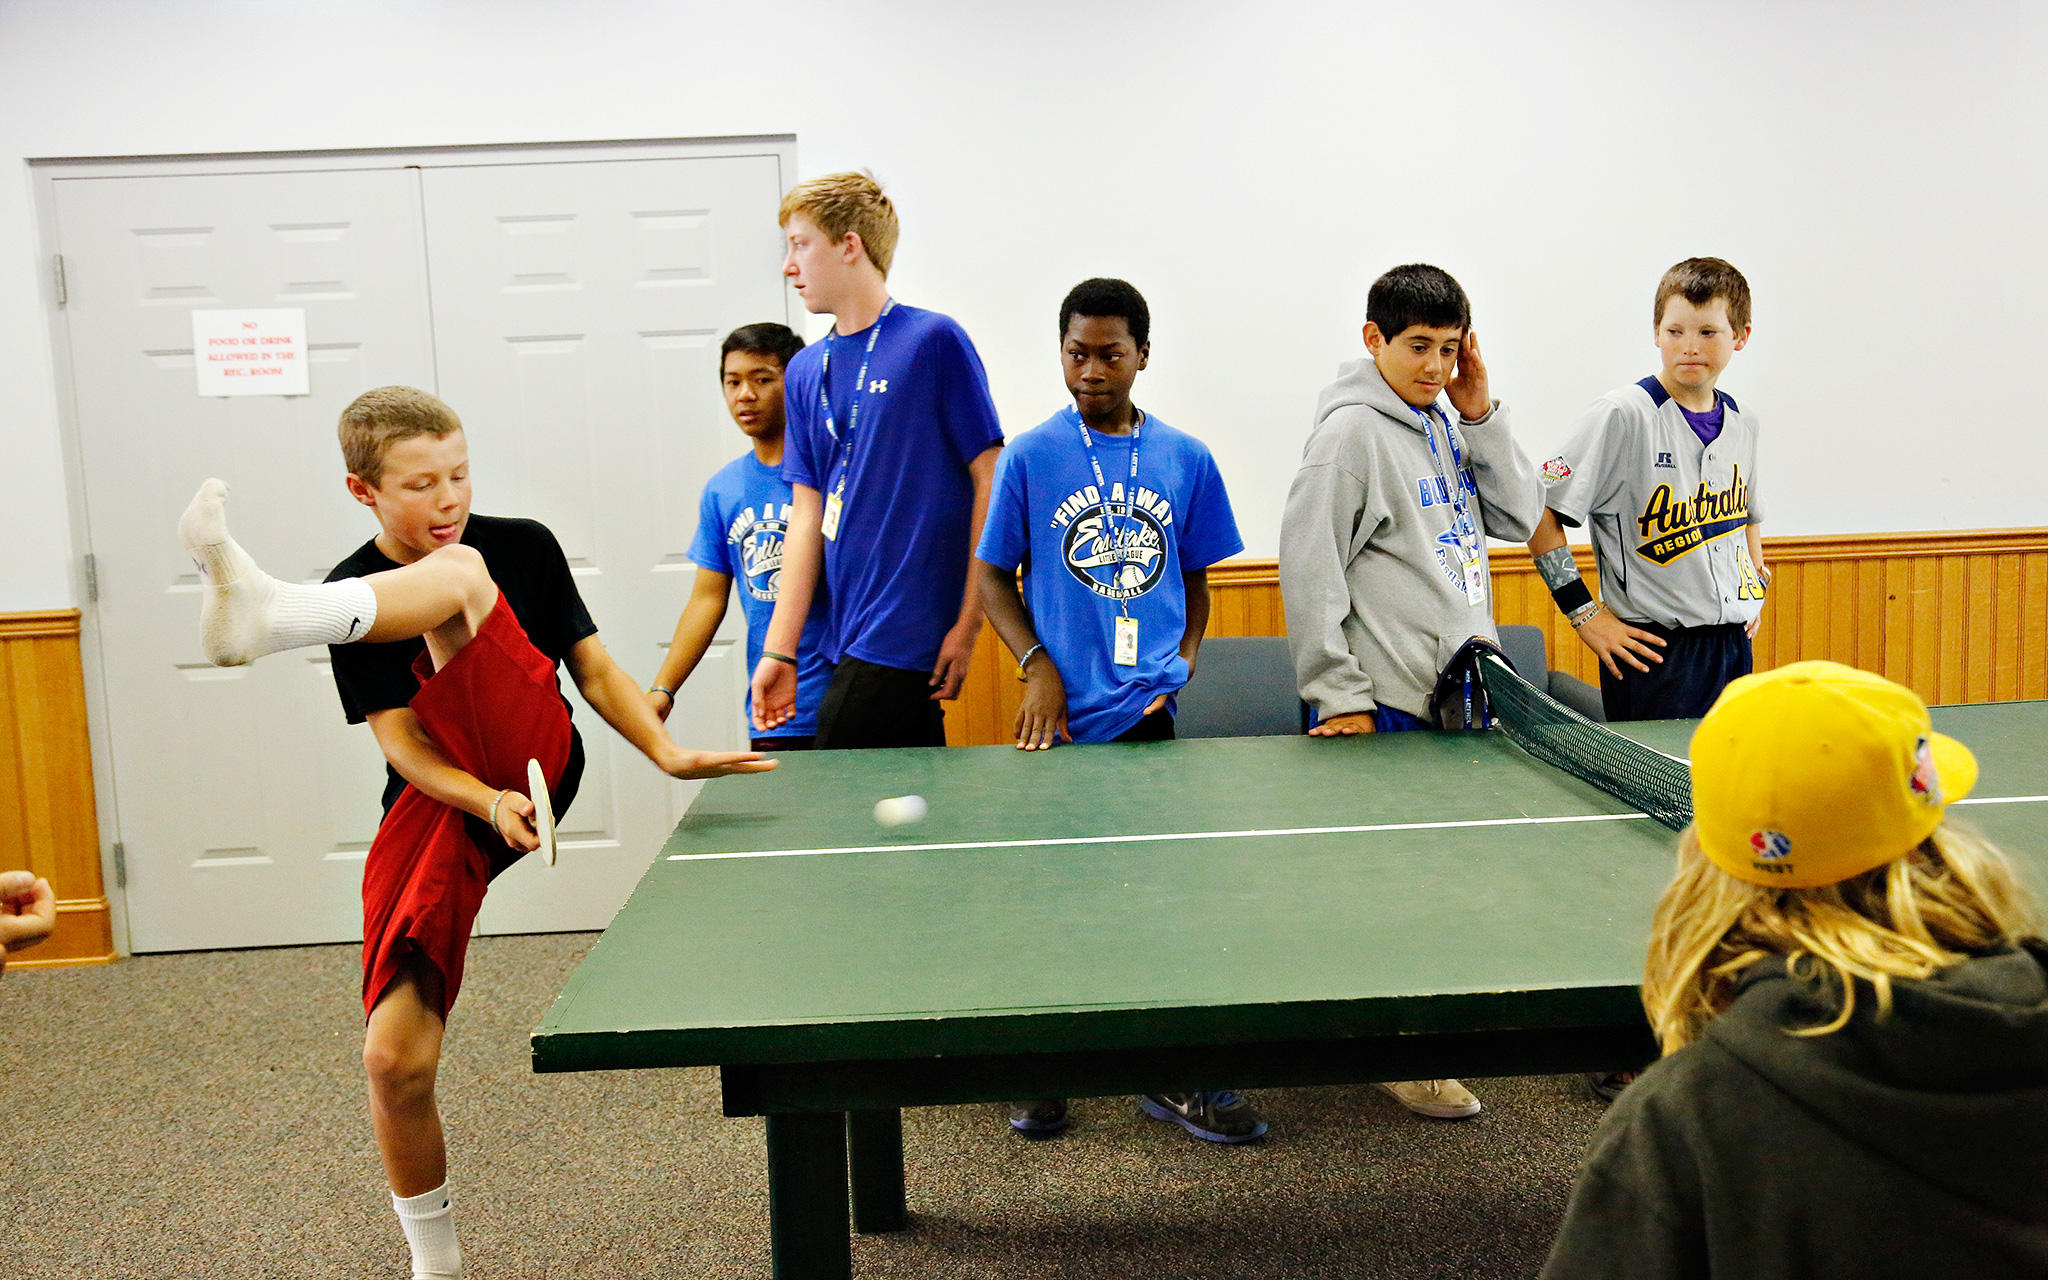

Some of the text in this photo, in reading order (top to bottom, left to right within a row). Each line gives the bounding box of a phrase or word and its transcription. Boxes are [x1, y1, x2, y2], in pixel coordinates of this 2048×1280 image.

[241, 322, 258, 330] NO
[208, 336, 293, 346] FOOD OR DRINK
[208, 351, 296, 361] ALLOWED IN THE
[250, 367, 283, 376] ROOM
[1111, 482, 1125, 502] A
[1637, 463, 1748, 537] Autrali
[762, 503, 774, 520] A
[1653, 528, 1703, 556] REGIO
[1435, 547, 1467, 594] Eastlak
[1753, 862, 1793, 874] WEST
